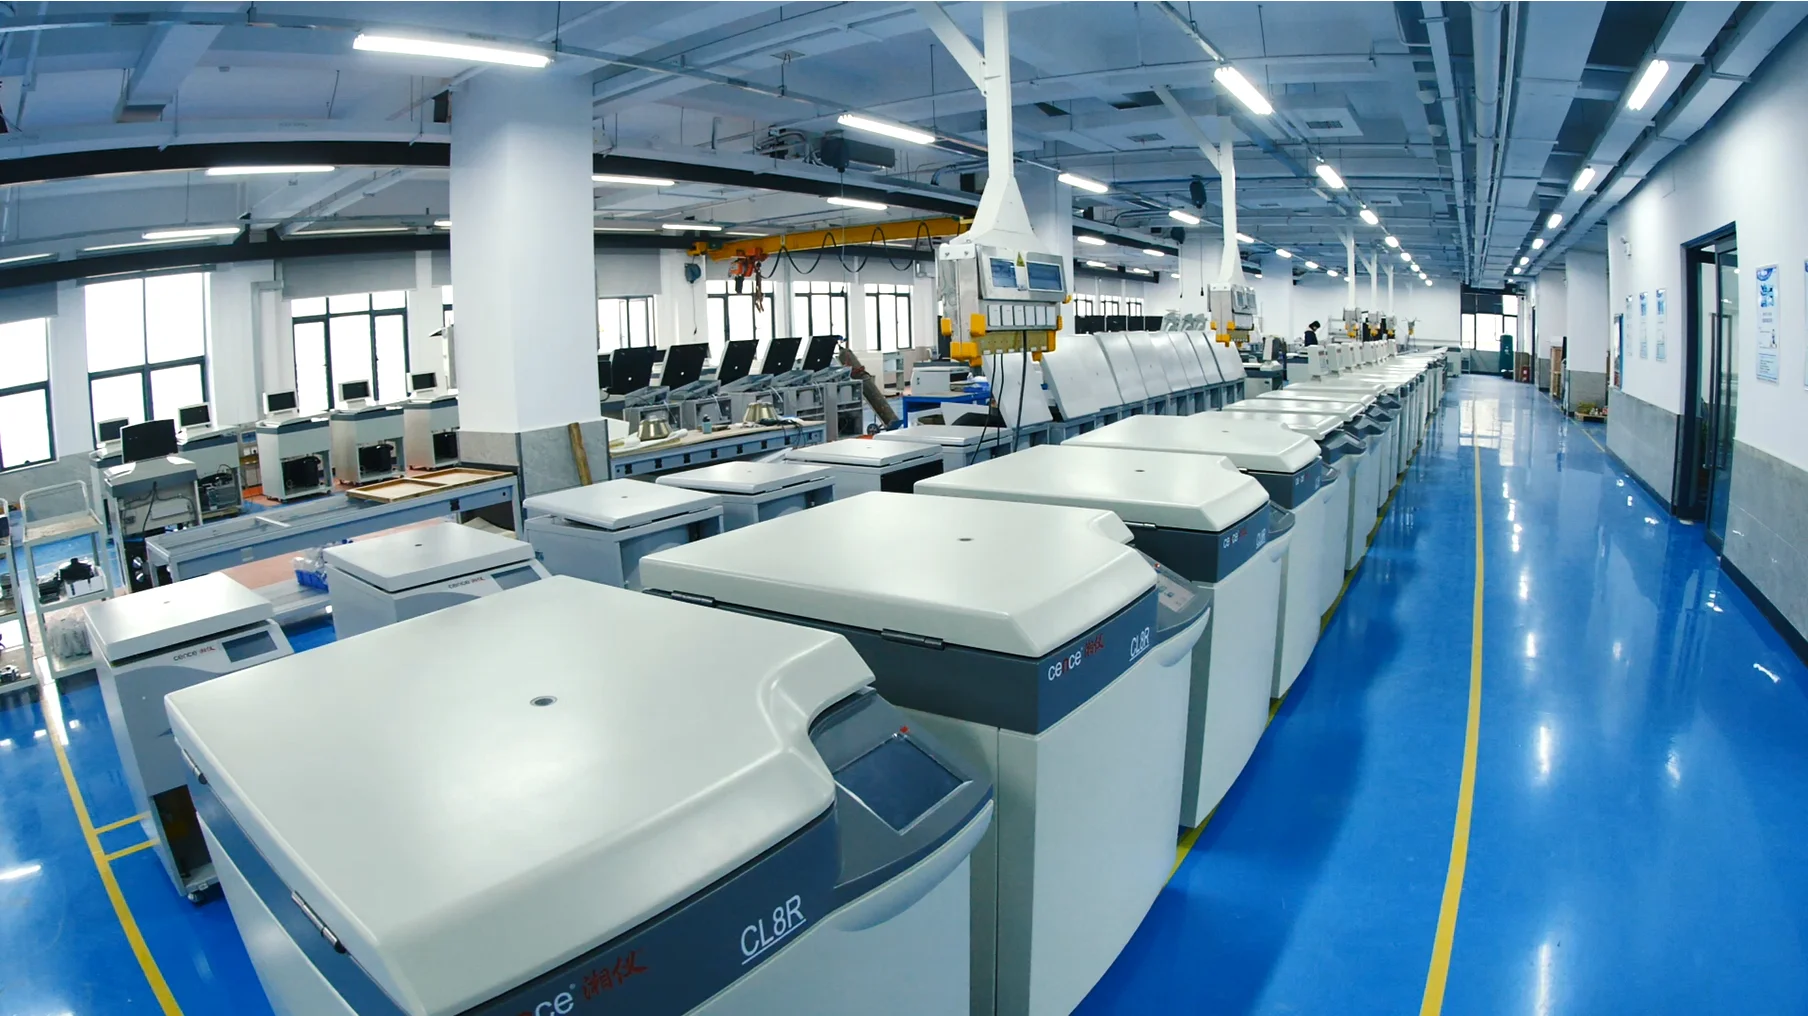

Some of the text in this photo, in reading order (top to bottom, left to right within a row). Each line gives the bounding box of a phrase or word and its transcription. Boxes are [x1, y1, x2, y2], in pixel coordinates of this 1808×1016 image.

[1130, 626, 1150, 659] CL8R
[1047, 650, 1082, 681] cence
[740, 894, 806, 962] CL8R
